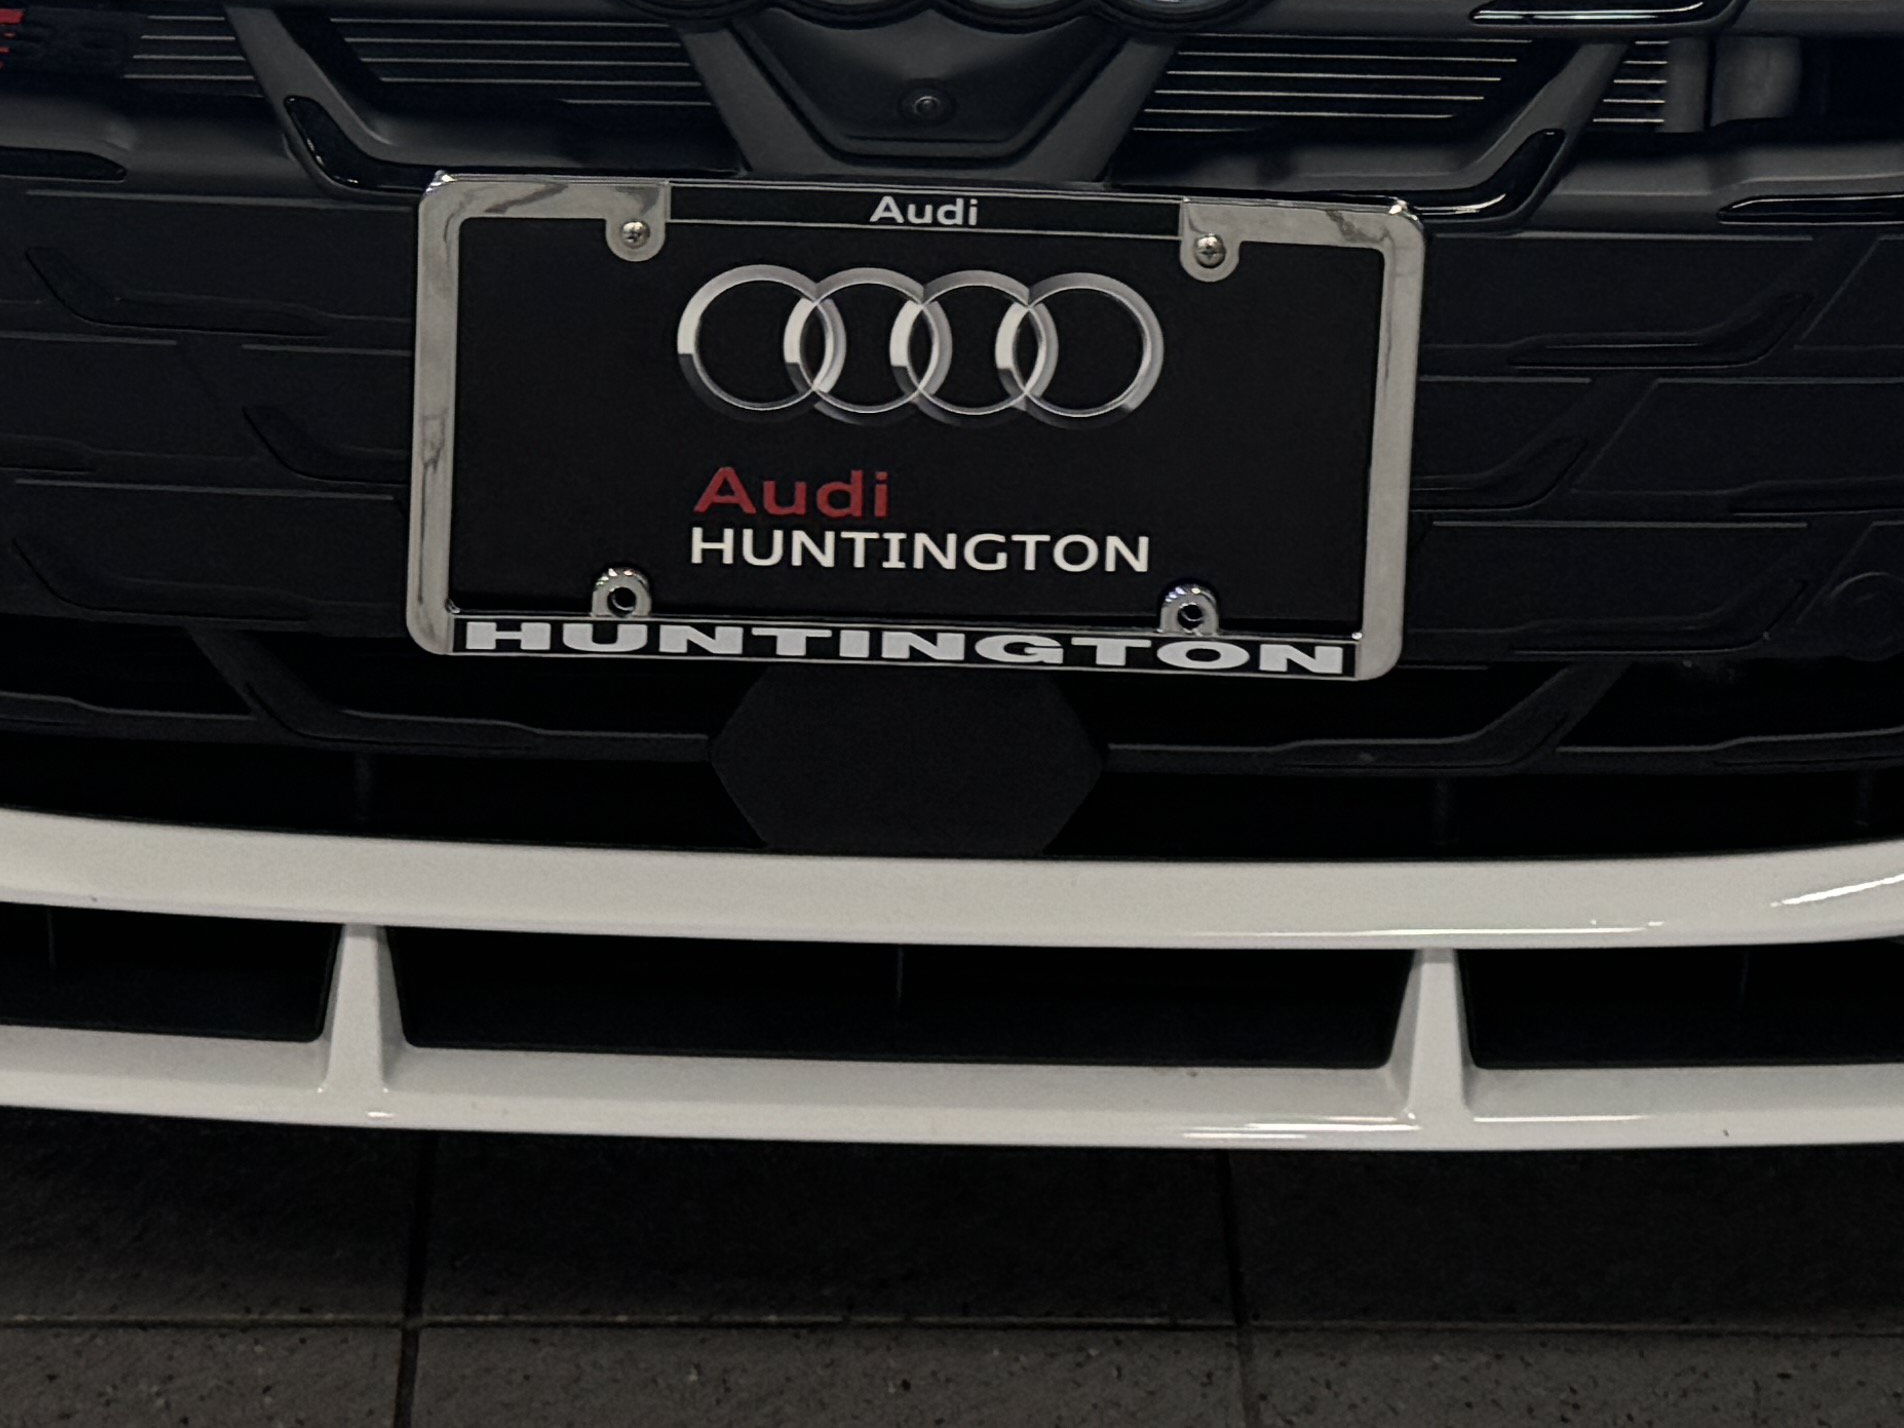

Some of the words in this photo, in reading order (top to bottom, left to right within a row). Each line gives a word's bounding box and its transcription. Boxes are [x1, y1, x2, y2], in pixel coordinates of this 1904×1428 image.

[869, 194, 980, 227] Audi
[695, 466, 888, 519] Audi
[690, 527, 1150, 573] HUNTINGTON
[465, 621, 1344, 675] HUNTINGTON
